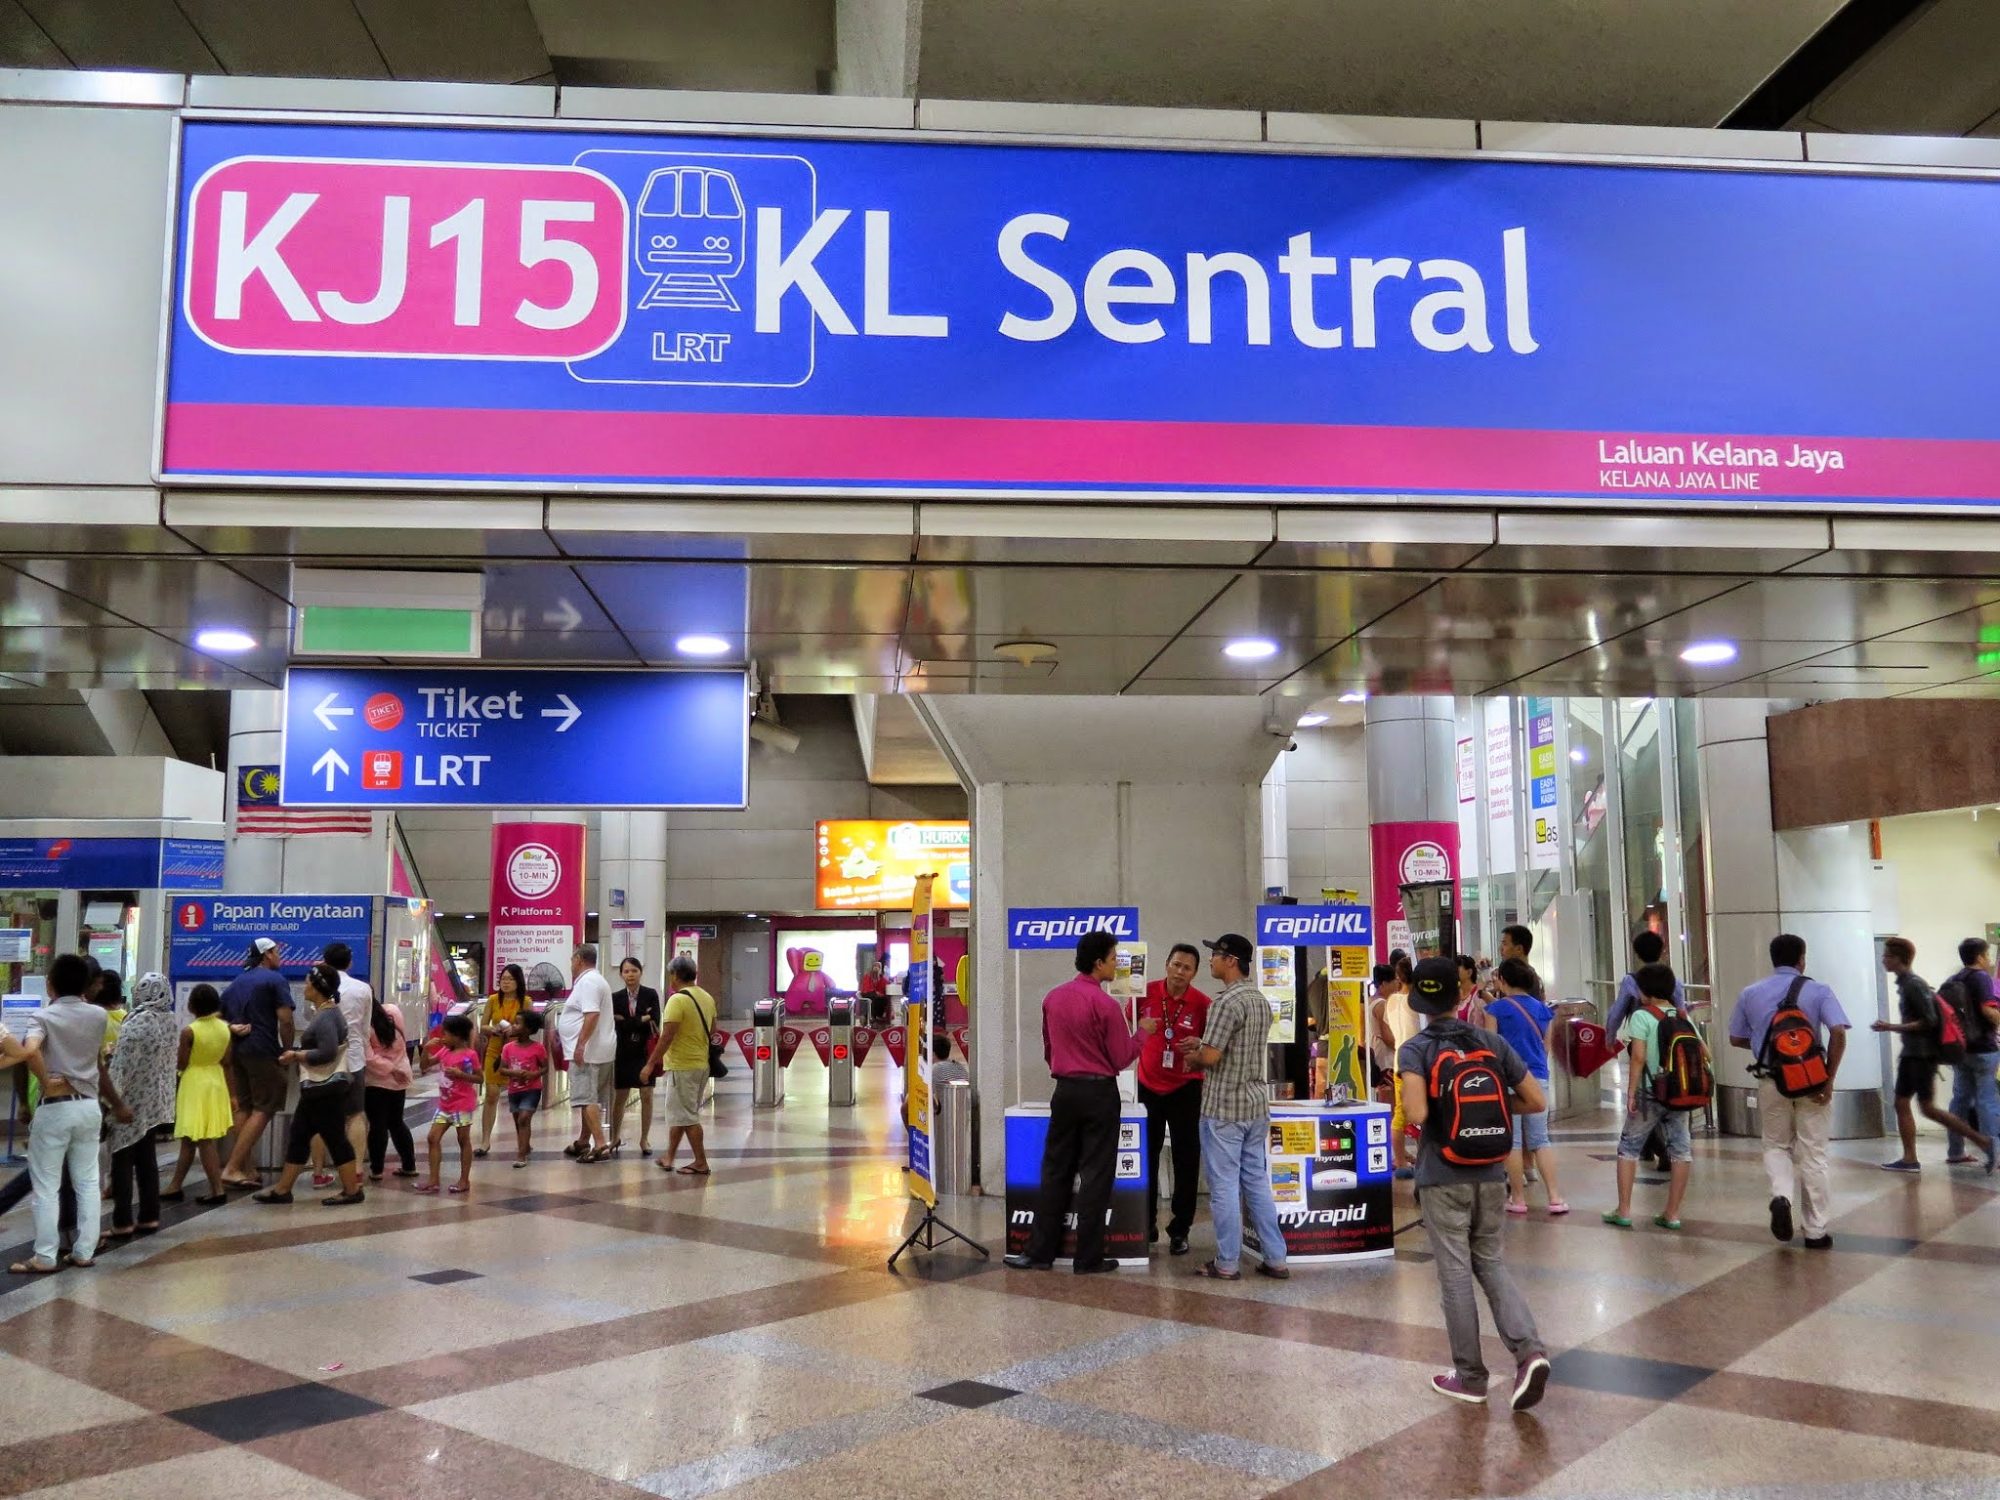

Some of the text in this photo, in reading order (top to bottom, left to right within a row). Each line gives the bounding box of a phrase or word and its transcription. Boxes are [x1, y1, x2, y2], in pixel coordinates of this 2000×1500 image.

[213, 190, 600, 331] KJ15
[755, 207, 1540, 355] KL Sentral
[652, 332, 731, 363] LRT
[1599, 439, 1845, 474] Laluan Kelana Jaya
[1600, 470, 1760, 490] KELANA JAYA LINE
[370, 702, 397, 717] TIKET
[417, 687, 524, 720] Tiket
[416, 722, 482, 738] TICKET
[414, 755, 491, 786] LRT
[519, 871, 549, 880] 10-MIN
[213, 902, 364, 922] Papan Kenyataan
[511, 906, 562, 916] Platform 2
[212, 922, 300, 932] INFORMATION BOARD
[496, 928, 564, 937] Perbankan pantas
[1015, 915, 1133, 941] rapidKL
[1264, 912, 1367, 939] rapidKL
[523, 937, 533, 945] 10
[1314, 1153, 1354, 1164] myrapid
